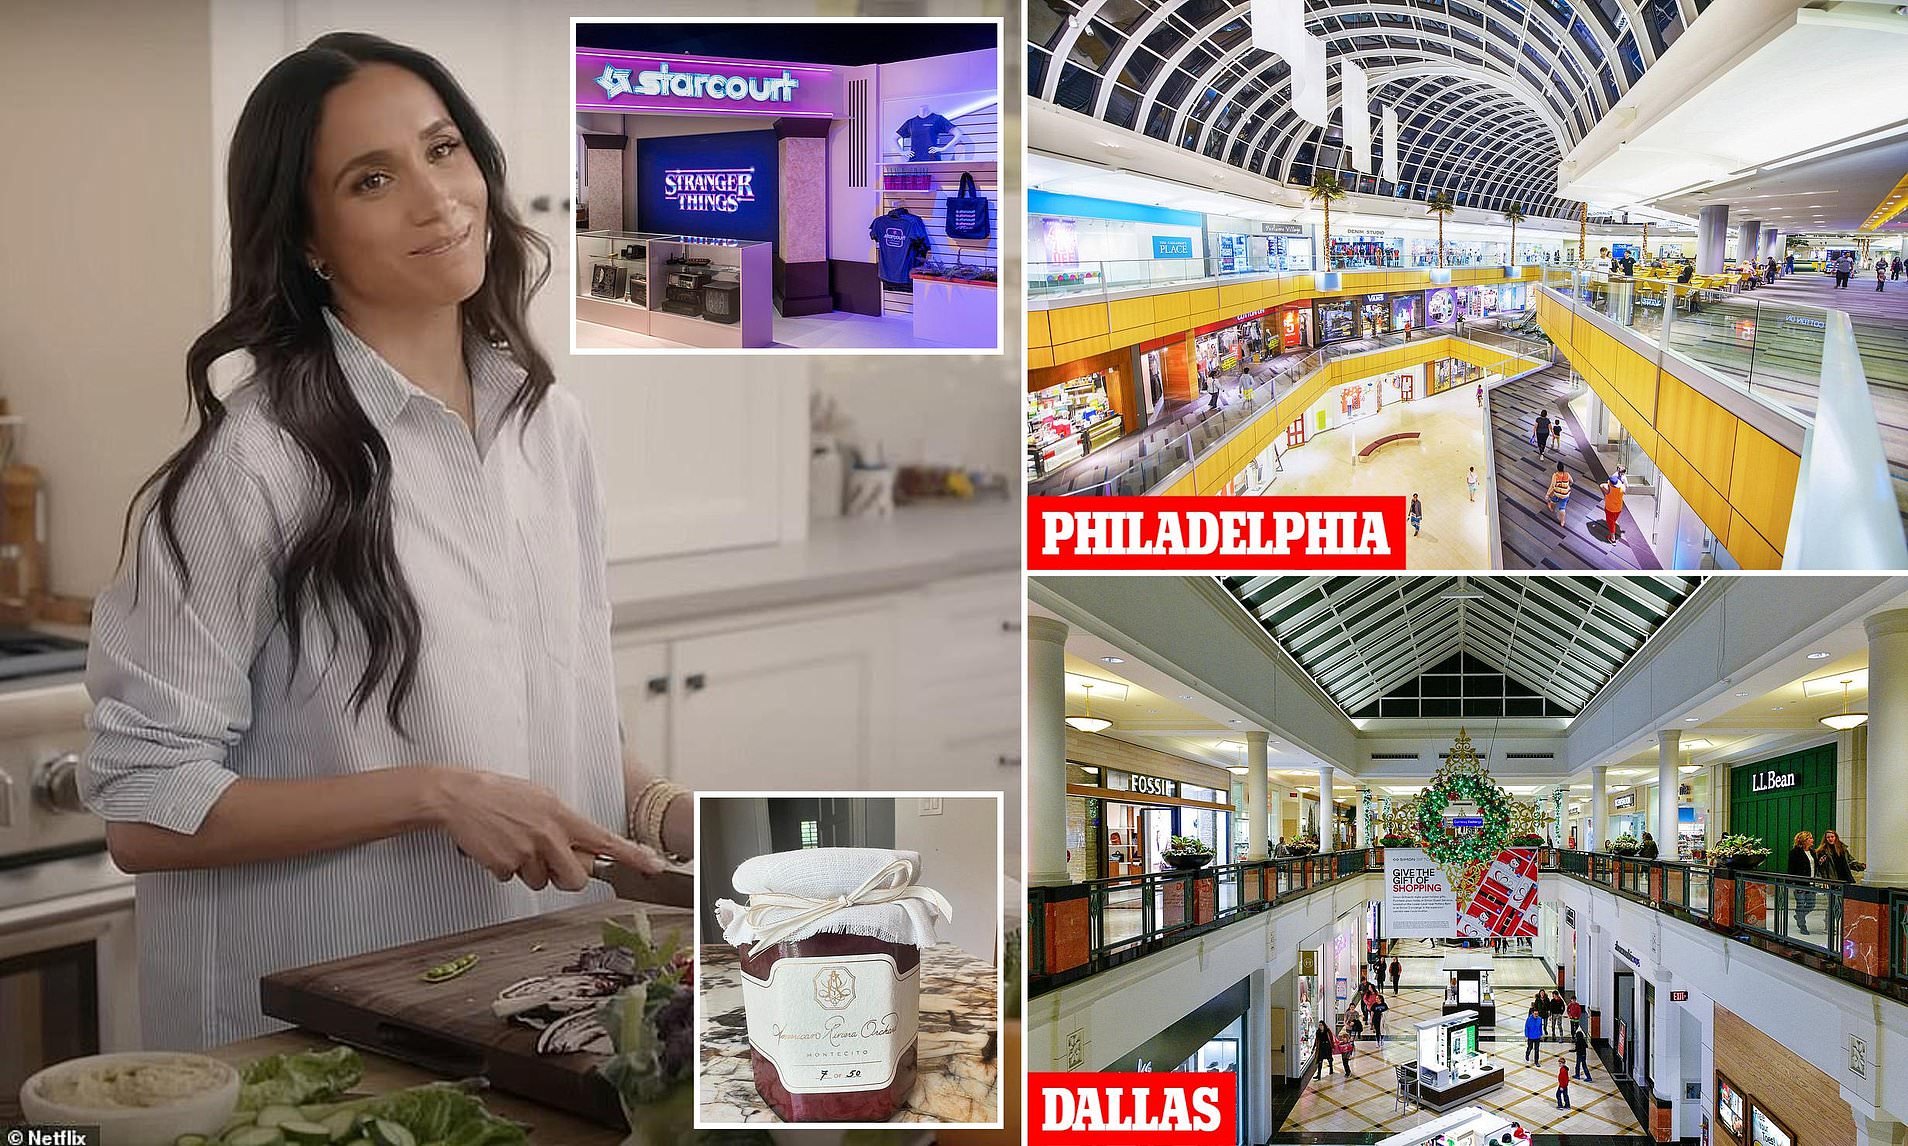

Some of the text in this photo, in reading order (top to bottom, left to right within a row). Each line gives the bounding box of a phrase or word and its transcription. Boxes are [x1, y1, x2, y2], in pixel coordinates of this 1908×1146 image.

[632, 62, 799, 102] starcourt
[665, 173, 755, 196] STRANGER
[678, 193, 739, 212] THINGS
[1160, 244, 1188, 254] PLACE
[1131, 775, 1176, 797] FOSSIL
[1393, 868, 1435, 876] GIVE THE
[1393, 876, 1430, 884] GIFT OF
[1393, 884, 1441, 892] SHOPPING
[1673, 992, 1684, 1001] EXIT
[820, 1070, 828, 1081] 7
[846, 1070, 861, 1078] 50
